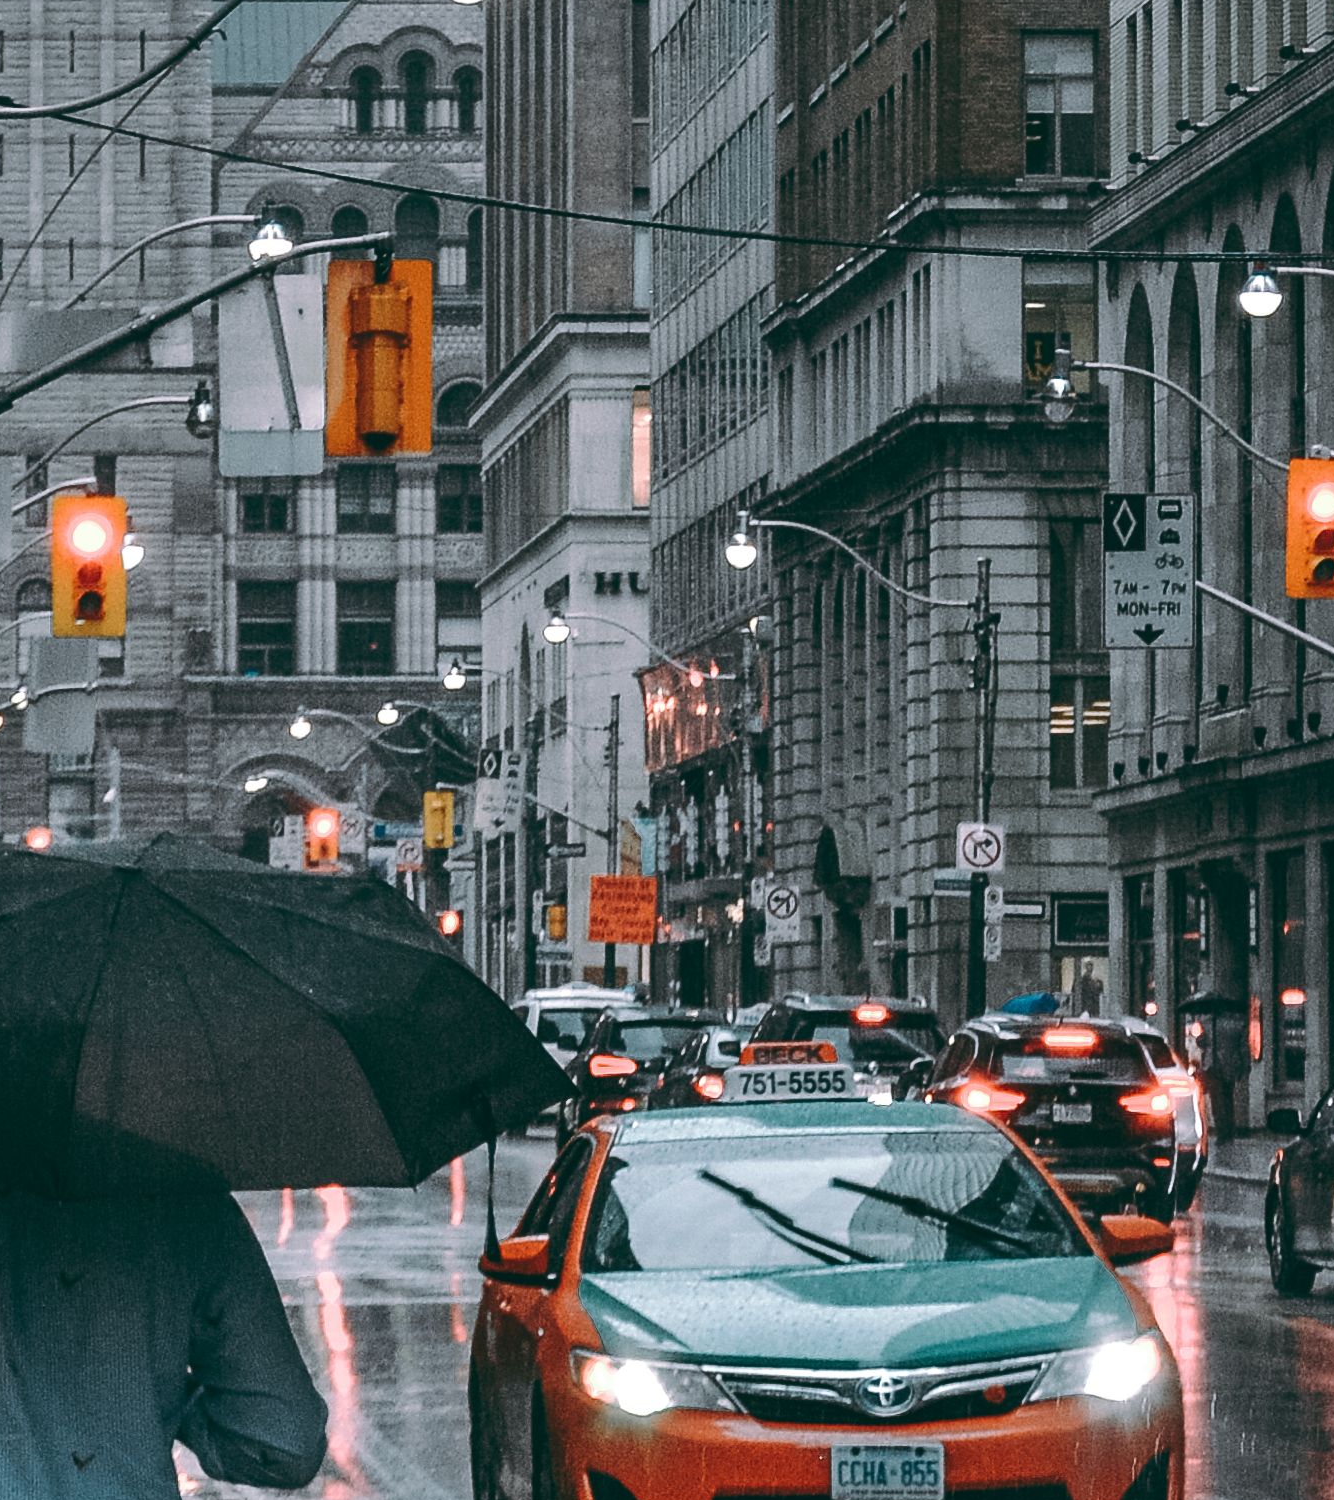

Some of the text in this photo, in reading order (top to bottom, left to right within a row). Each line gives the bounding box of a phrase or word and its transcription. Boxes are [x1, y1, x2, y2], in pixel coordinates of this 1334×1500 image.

[1116, 601, 1181, 617] MON-FRI
[754, 1046, 821, 1065] BECK
[739, 1069, 847, 1096] 751-5555
